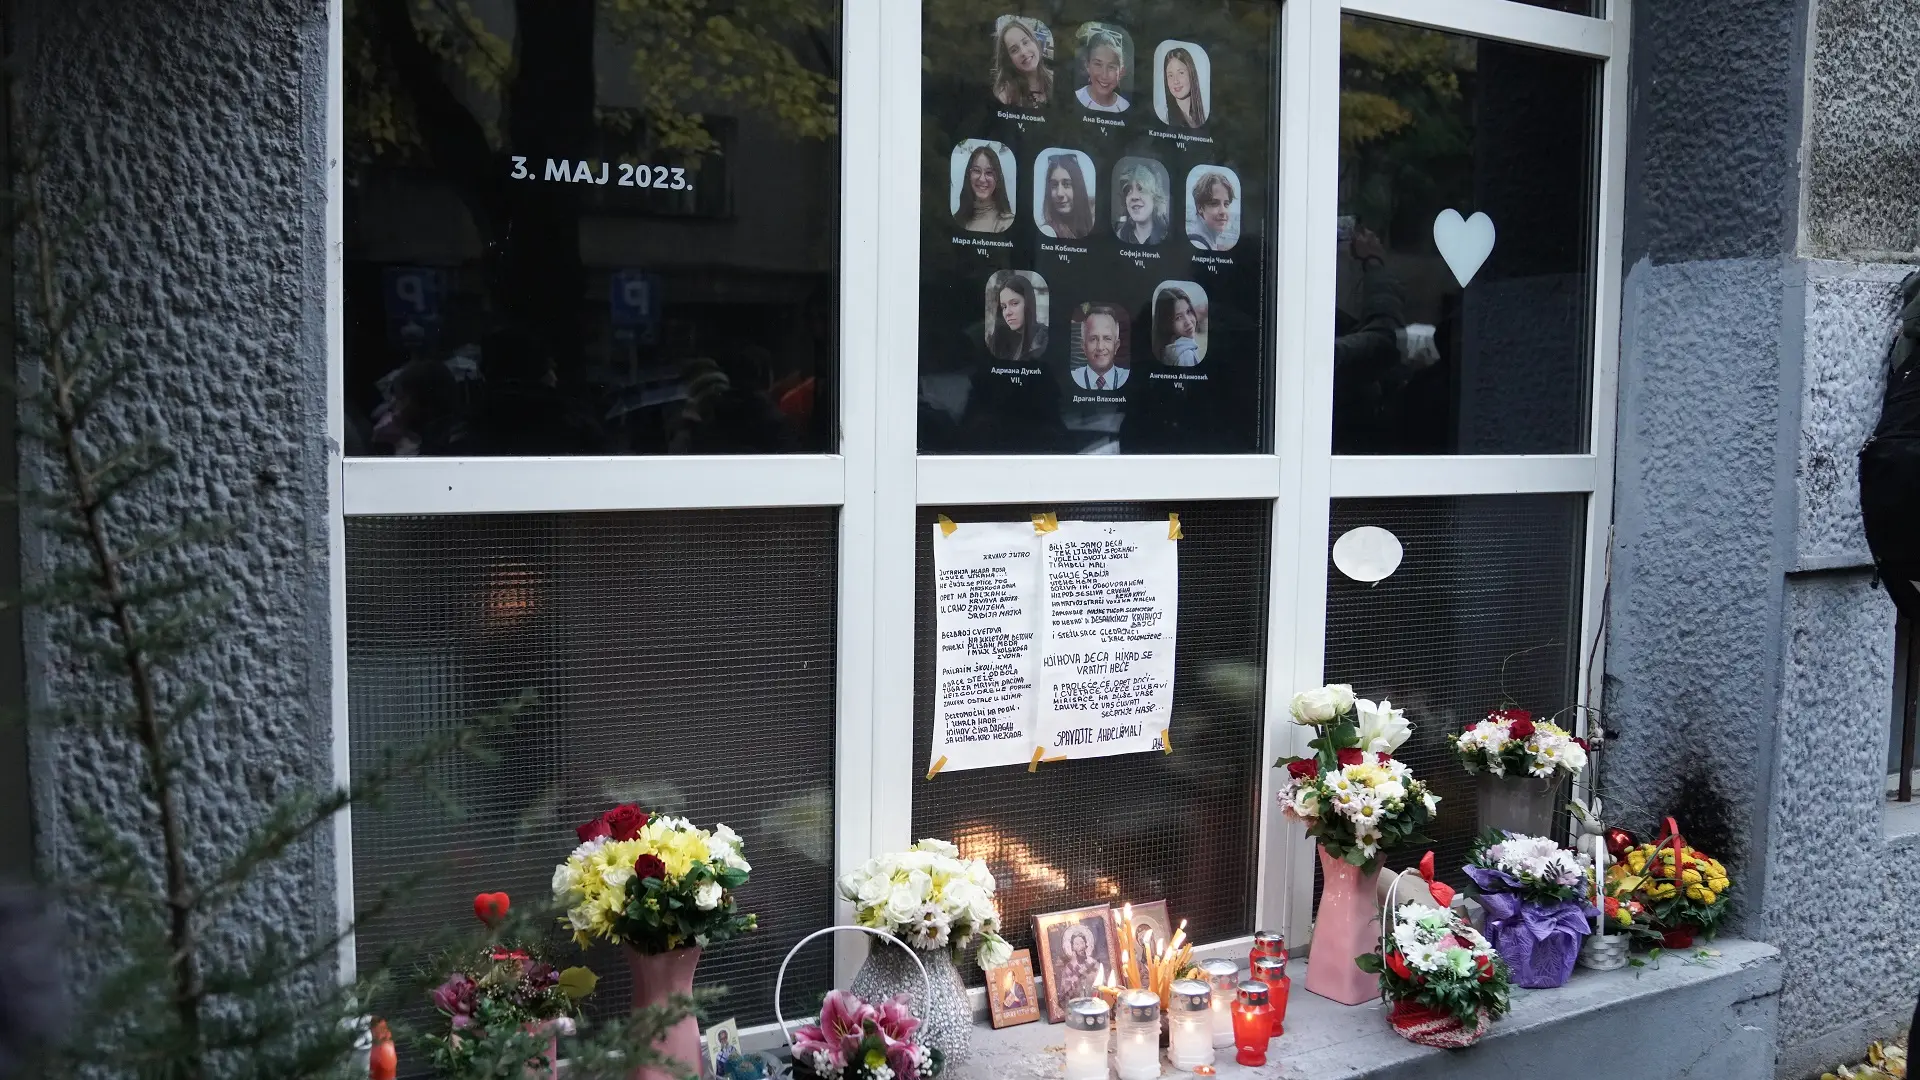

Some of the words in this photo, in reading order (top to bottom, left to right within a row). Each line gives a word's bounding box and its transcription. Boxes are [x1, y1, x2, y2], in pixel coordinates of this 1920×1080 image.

[997, 110, 1020, 120] Бојана
[1083, 115, 1096, 123] Ана
[1096, 117, 1125, 127] Божовић
[1148, 129, 1177, 140] Катарина
[1177, 133, 1214, 144] Мартиновић
[511, 155, 536, 180] 3.
[617, 163, 694, 191] 2023.
[952, 236, 971, 246] Мара
[972, 238, 1014, 248] Анђелковић
[1041, 243, 1054, 251] Ема
[1054, 244, 1088, 254] Кобиљски
[1119, 249, 1142, 259] Софија
[1191, 255, 1216, 264] Андрија
[990, 366, 1020, 376] Адриана
[1020, 367, 1042, 376] Дукић
[1149, 372, 1178, 380] Ангелина
[1072, 395, 1096, 404] Драган
[1096, 395, 1127, 403] Влаховић
[1008, 550, 1031, 560] JUTRO
[1048, 570, 1081, 581] TUGUJE
[1082, 568, 1110, 580] SRBIJA
[1083, 651, 1109, 664] DECA
[1140, 650, 1153, 660] SE
[1053, 727, 1094, 747] SPAVAJTE
